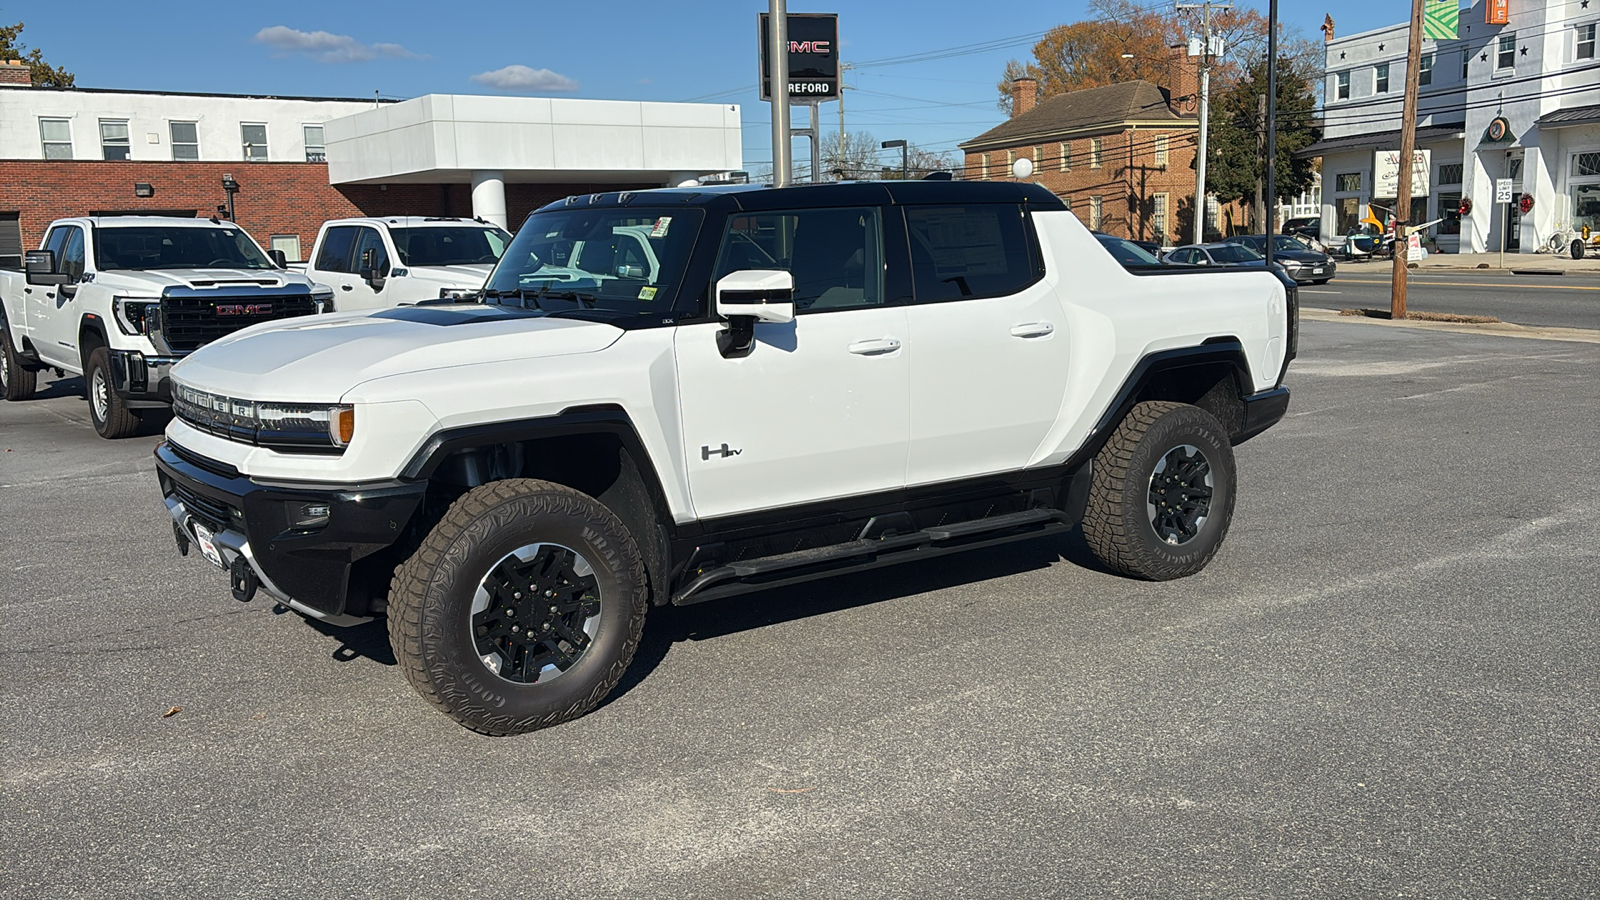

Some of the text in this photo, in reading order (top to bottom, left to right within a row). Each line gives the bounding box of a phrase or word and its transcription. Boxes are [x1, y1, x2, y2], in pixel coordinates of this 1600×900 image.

[787, 41, 830, 53] MC
[788, 83, 829, 93] REFORD
[1498, 191, 1511, 200] 25
[217, 304, 273, 316] GMC
